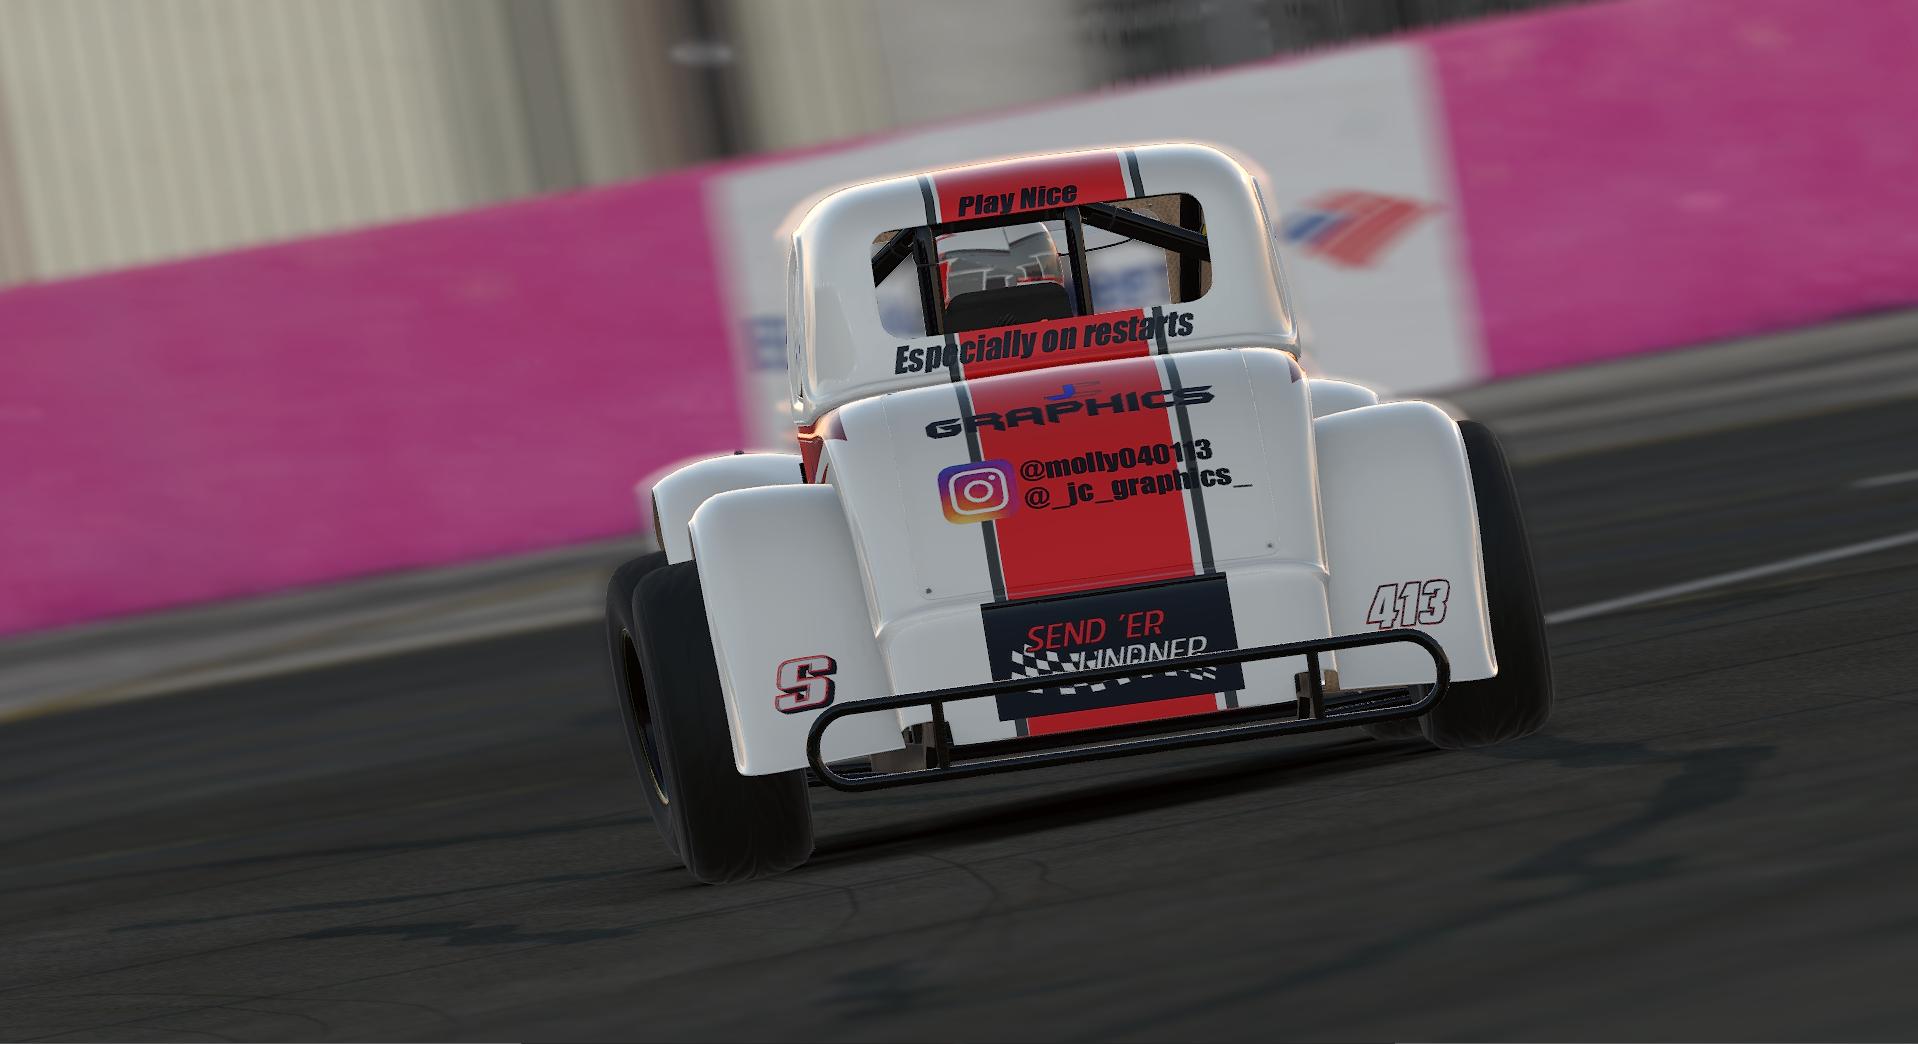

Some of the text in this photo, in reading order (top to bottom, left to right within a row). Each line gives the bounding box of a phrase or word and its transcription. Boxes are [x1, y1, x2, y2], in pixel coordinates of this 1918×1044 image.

[958, 184, 1078, 217] Play Nice
[894, 311, 1195, 375] Especially on restarts
[925, 385, 1215, 440] GRAPHICS
[1020, 438, 1213, 481] @molly040113
[1366, 579, 1451, 631] 413
[1026, 618, 1106, 653] SEND
[774, 654, 838, 715] S
